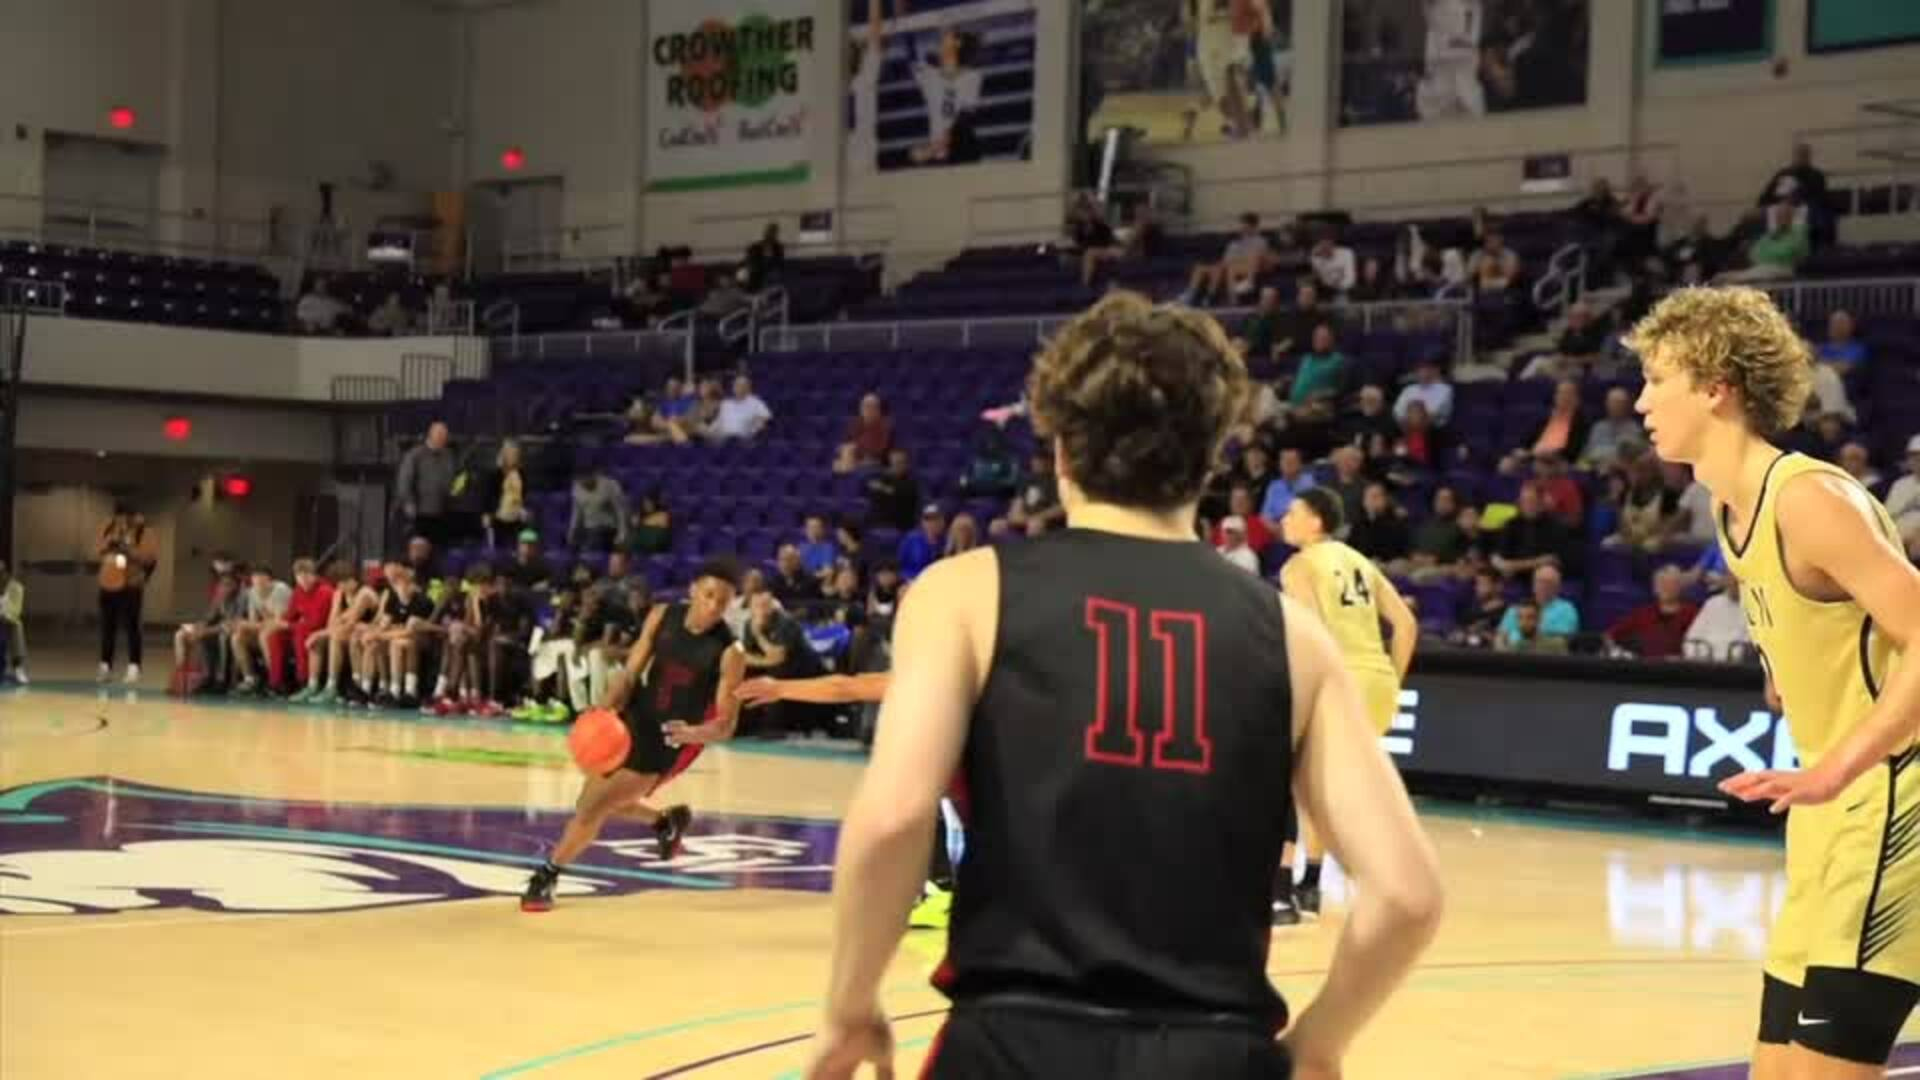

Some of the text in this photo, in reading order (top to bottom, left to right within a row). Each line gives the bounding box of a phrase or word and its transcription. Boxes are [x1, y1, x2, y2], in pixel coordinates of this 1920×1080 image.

[653, 17, 814, 66] CROWTHER
[667, 62, 798, 108] ROOFING
[1334, 567, 1370, 606] 24
[1086, 597, 1211, 773] 11
